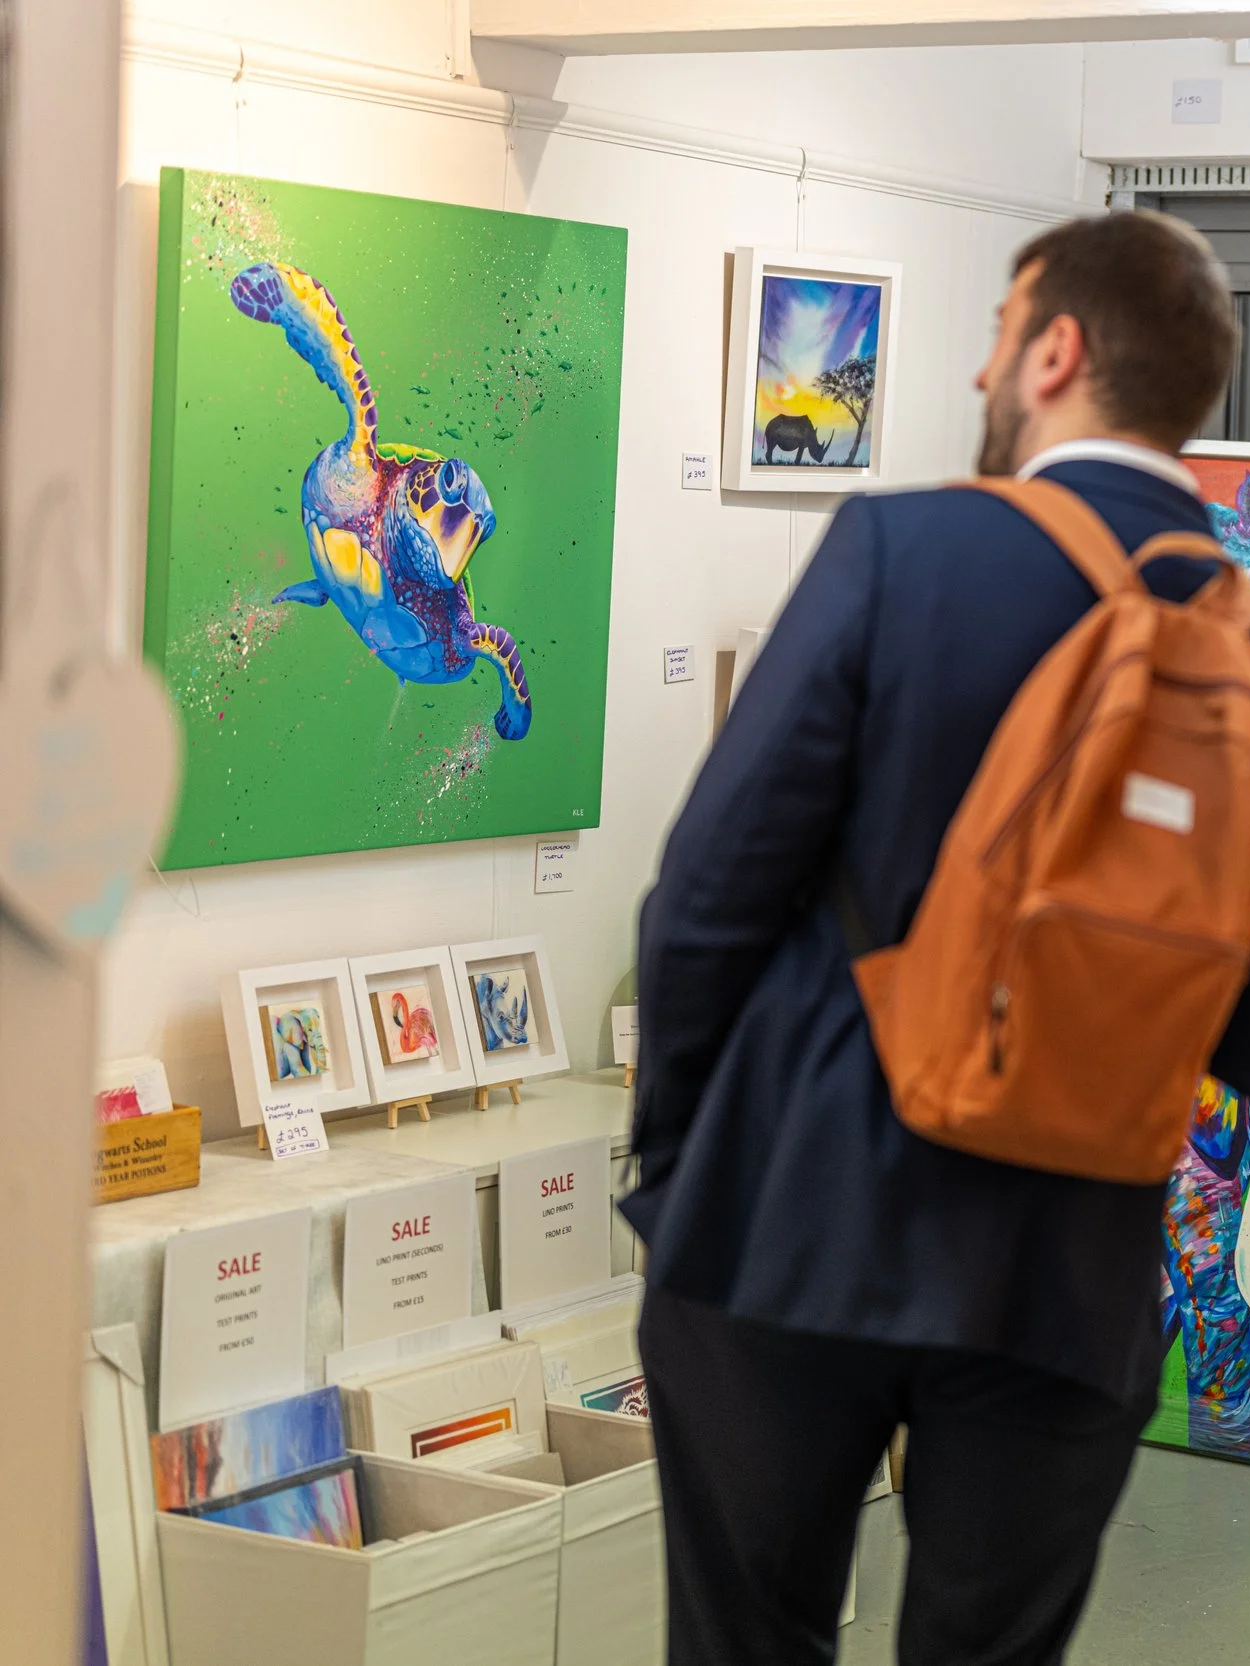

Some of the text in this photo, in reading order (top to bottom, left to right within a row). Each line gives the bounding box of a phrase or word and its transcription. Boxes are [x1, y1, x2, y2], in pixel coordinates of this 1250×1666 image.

[572, 808, 584, 817] KLE
[276, 1126, 309, 1144] £295
[132, 1135, 167, 1153] School
[541, 1172, 575, 1198] SALE
[556, 1202, 574, 1214] PRINTS
[391, 1215, 431, 1242] SALE
[545, 1228, 562, 1240] FROM
[392, 1250, 411, 1263] PRINT
[217, 1252, 262, 1281] SALE
[391, 1270, 428, 1287] TEST PRINTS
[214, 1284, 262, 1304] ORIGINAL ART
[393, 1298, 412, 1310] FROM
[234, 1310, 258, 1324] PRINTS
[219, 1340, 241, 1352] FROM
